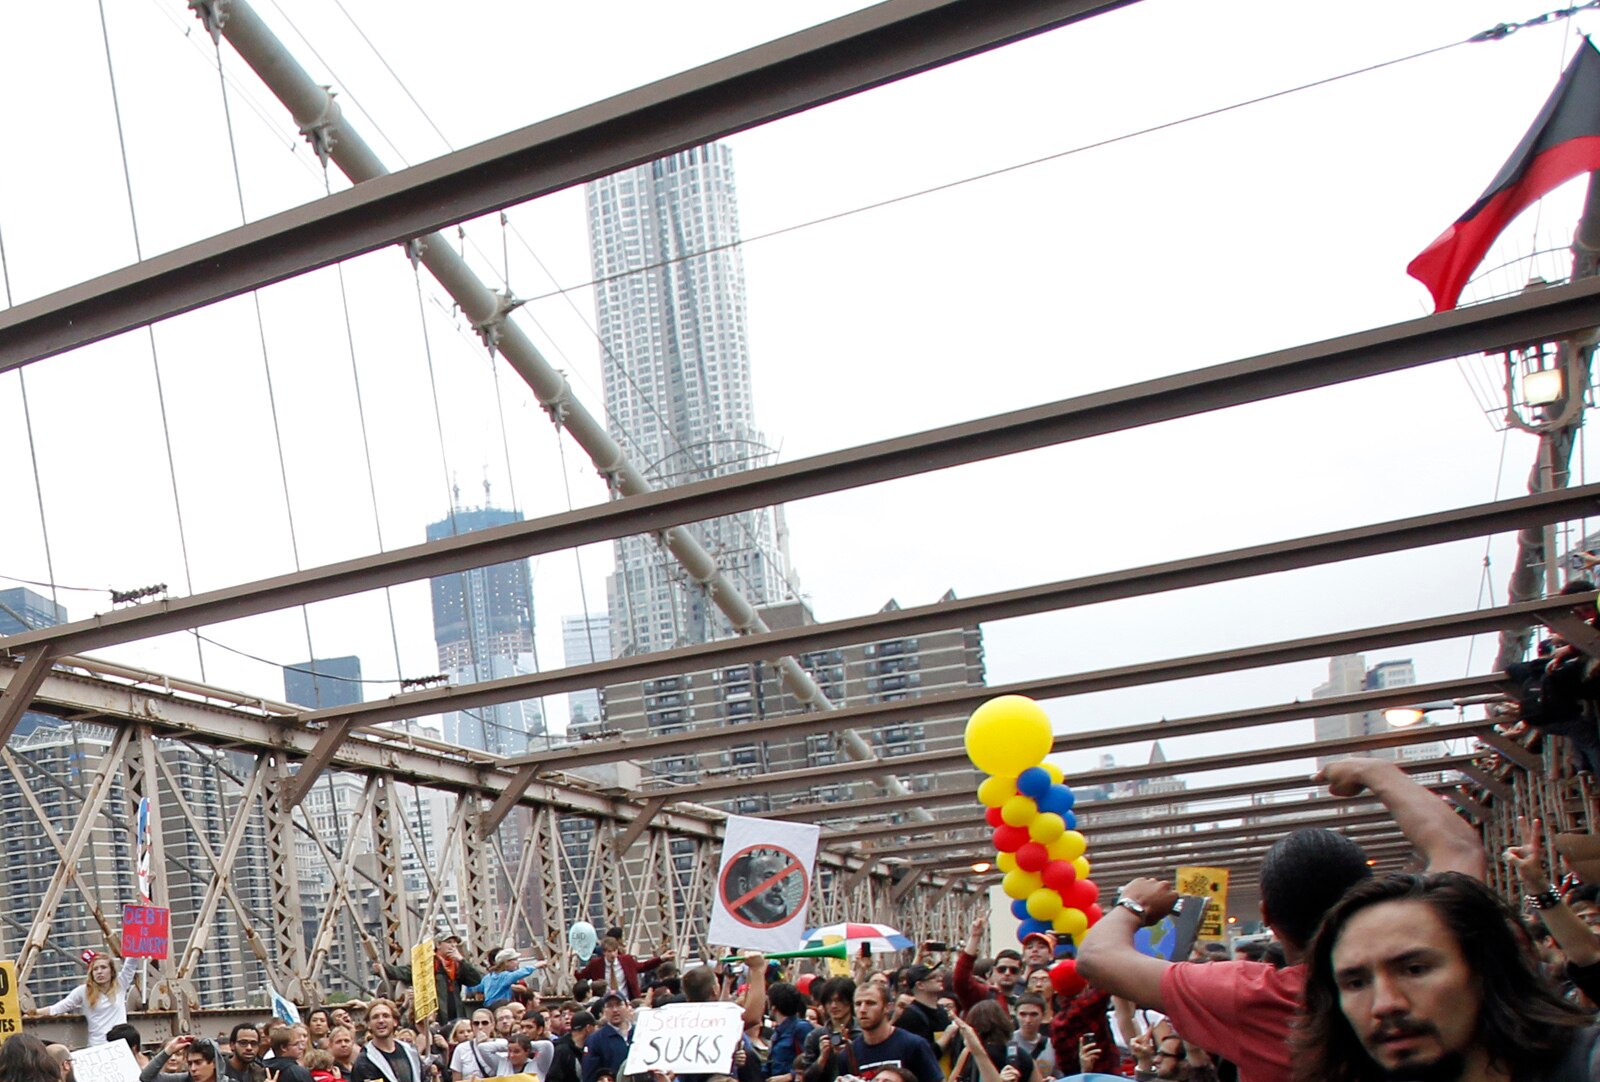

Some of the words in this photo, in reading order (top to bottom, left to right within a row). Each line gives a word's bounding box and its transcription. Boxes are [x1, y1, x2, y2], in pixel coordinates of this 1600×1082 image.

[124, 906, 167, 925] DEBT
[141, 926, 149, 936] IS
[124, 935, 168, 953] SLAVERY
[649, 1009, 727, 1032] Serfdom
[104, 1044, 126, 1061] IS
[643, 1034, 724, 1066] SUCKS
